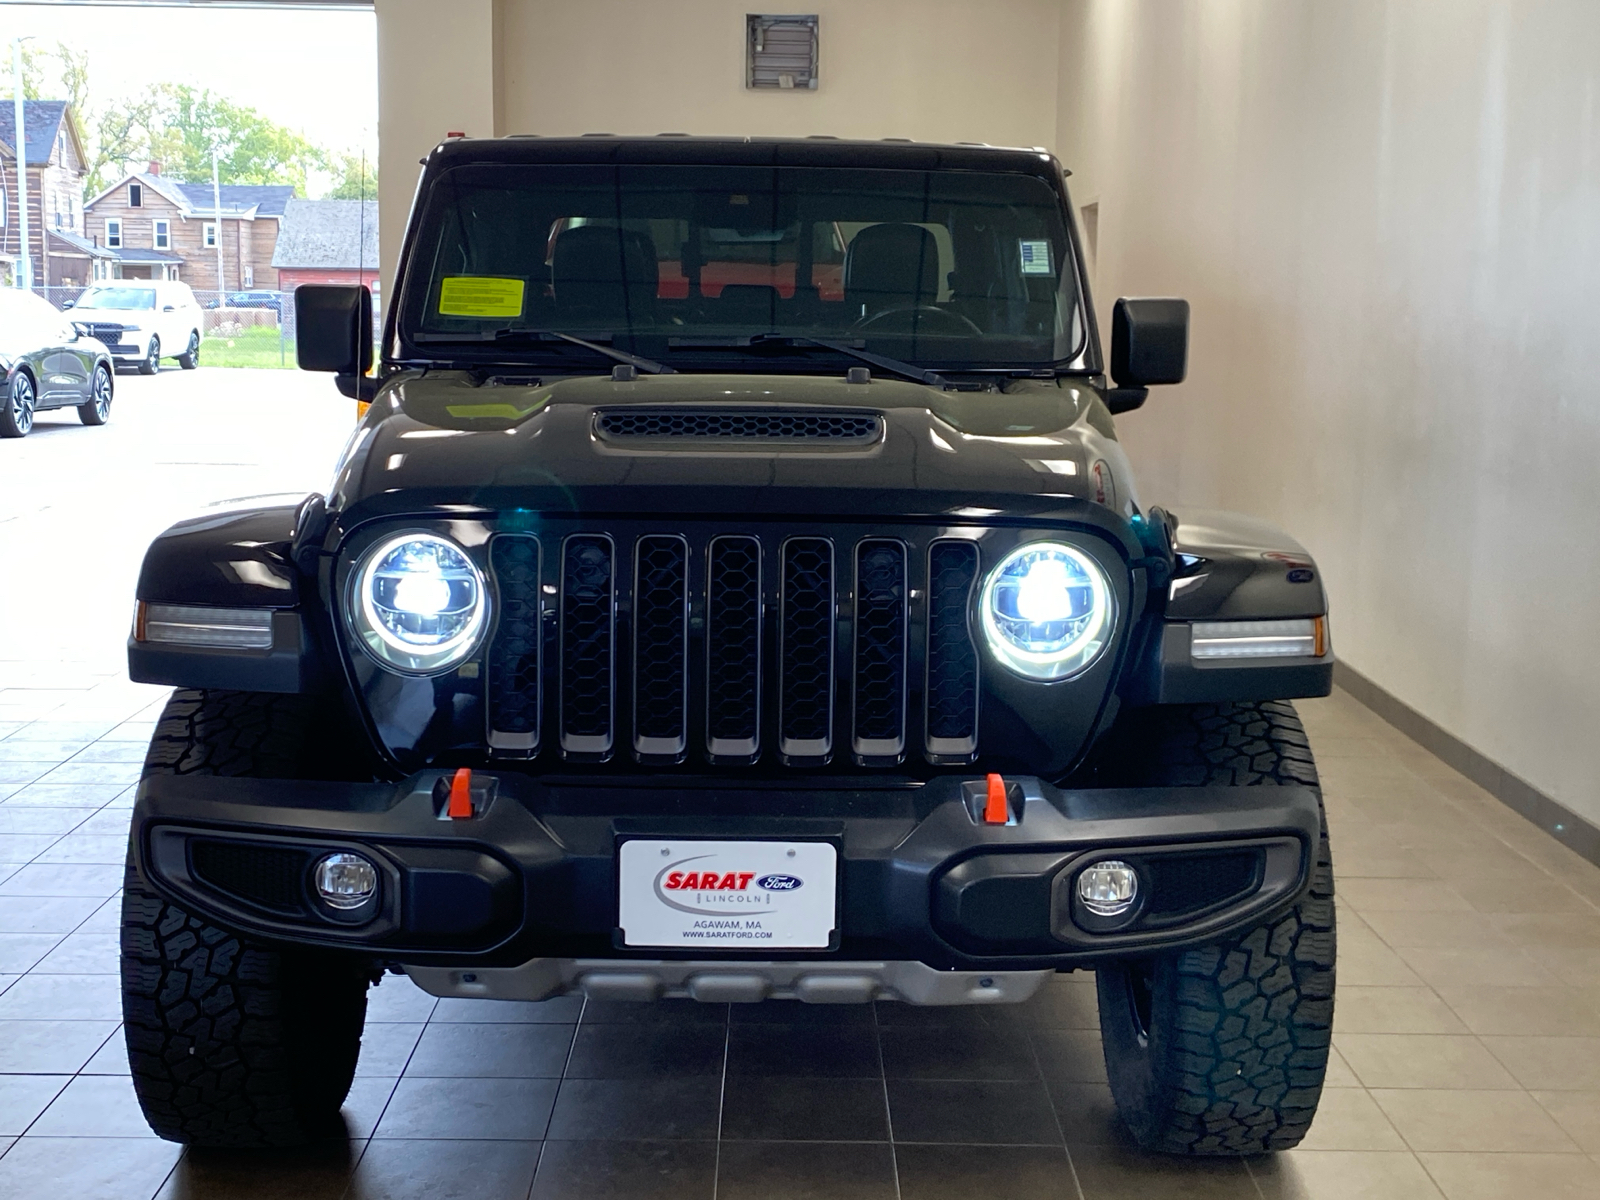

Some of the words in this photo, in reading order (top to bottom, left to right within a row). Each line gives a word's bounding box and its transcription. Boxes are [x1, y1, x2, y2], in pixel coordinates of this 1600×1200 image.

[664, 871, 756, 891] SARAT
[763, 875, 795, 891] Ford
[706, 895, 761, 903] LINCOLN
[693, 921, 743, 930] AGAWAM,
[745, 921, 762, 929] MA
[682, 931, 773, 939] WWW.SARATFORD.COM
